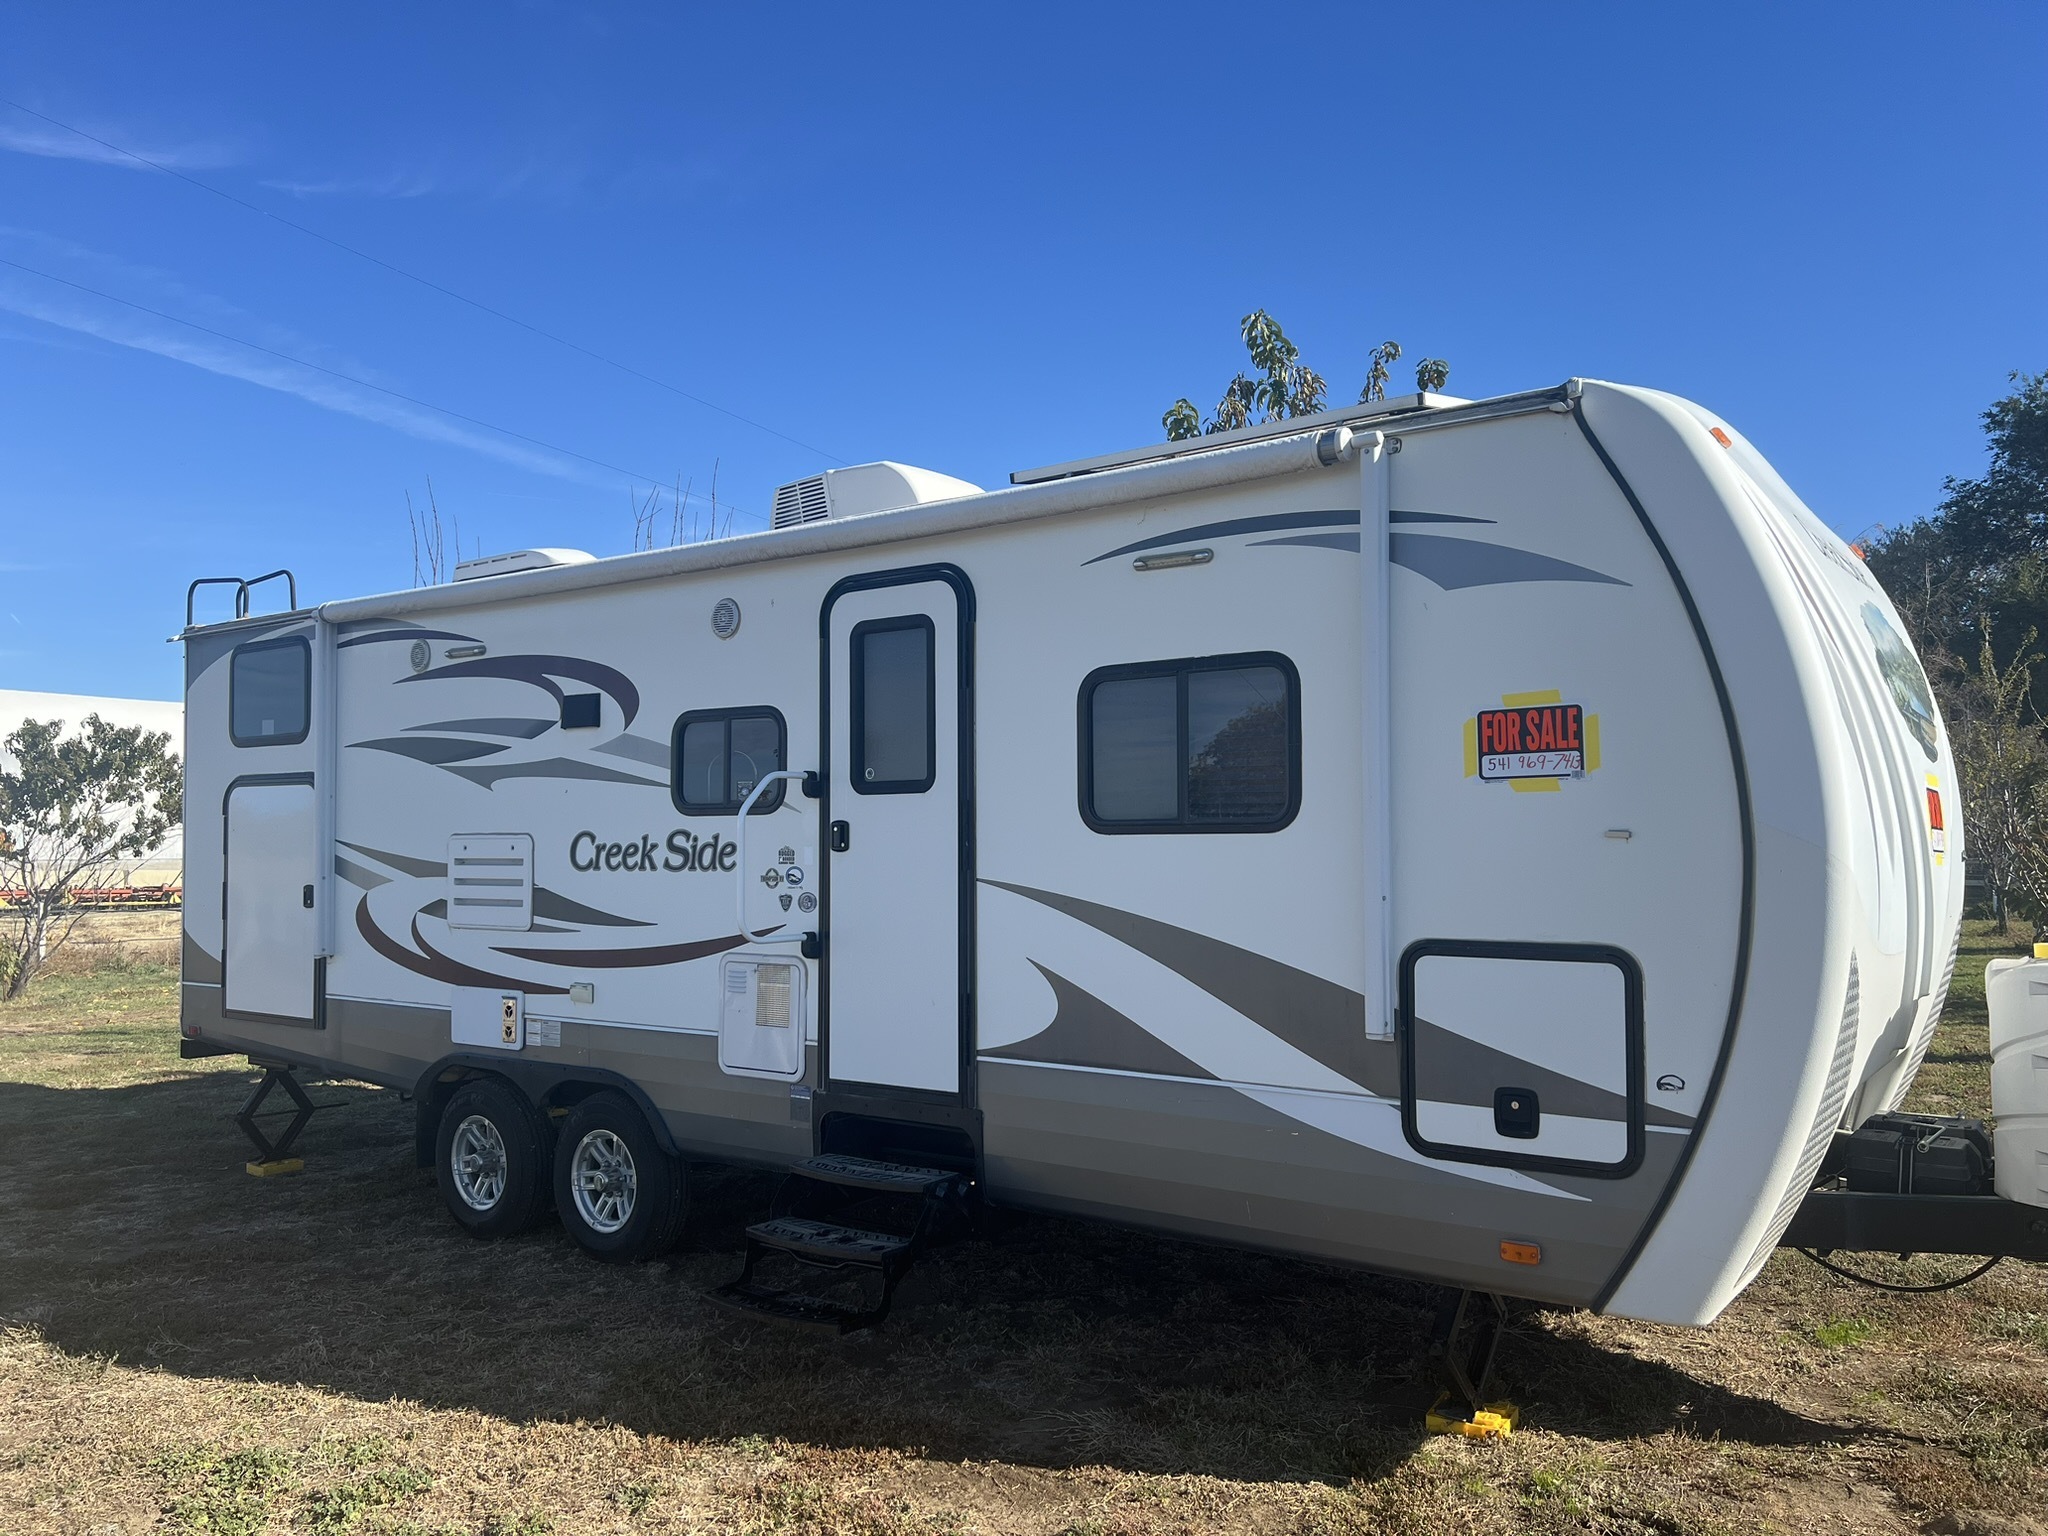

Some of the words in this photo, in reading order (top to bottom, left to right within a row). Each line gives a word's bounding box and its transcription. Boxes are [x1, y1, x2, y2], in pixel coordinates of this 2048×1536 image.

[1482, 712, 1521, 752] FOR
[1526, 708, 1579, 750] SALE
[1488, 756, 1511, 771] 541
[569, 829, 659, 872] Creek
[662, 828, 738, 872] Side
